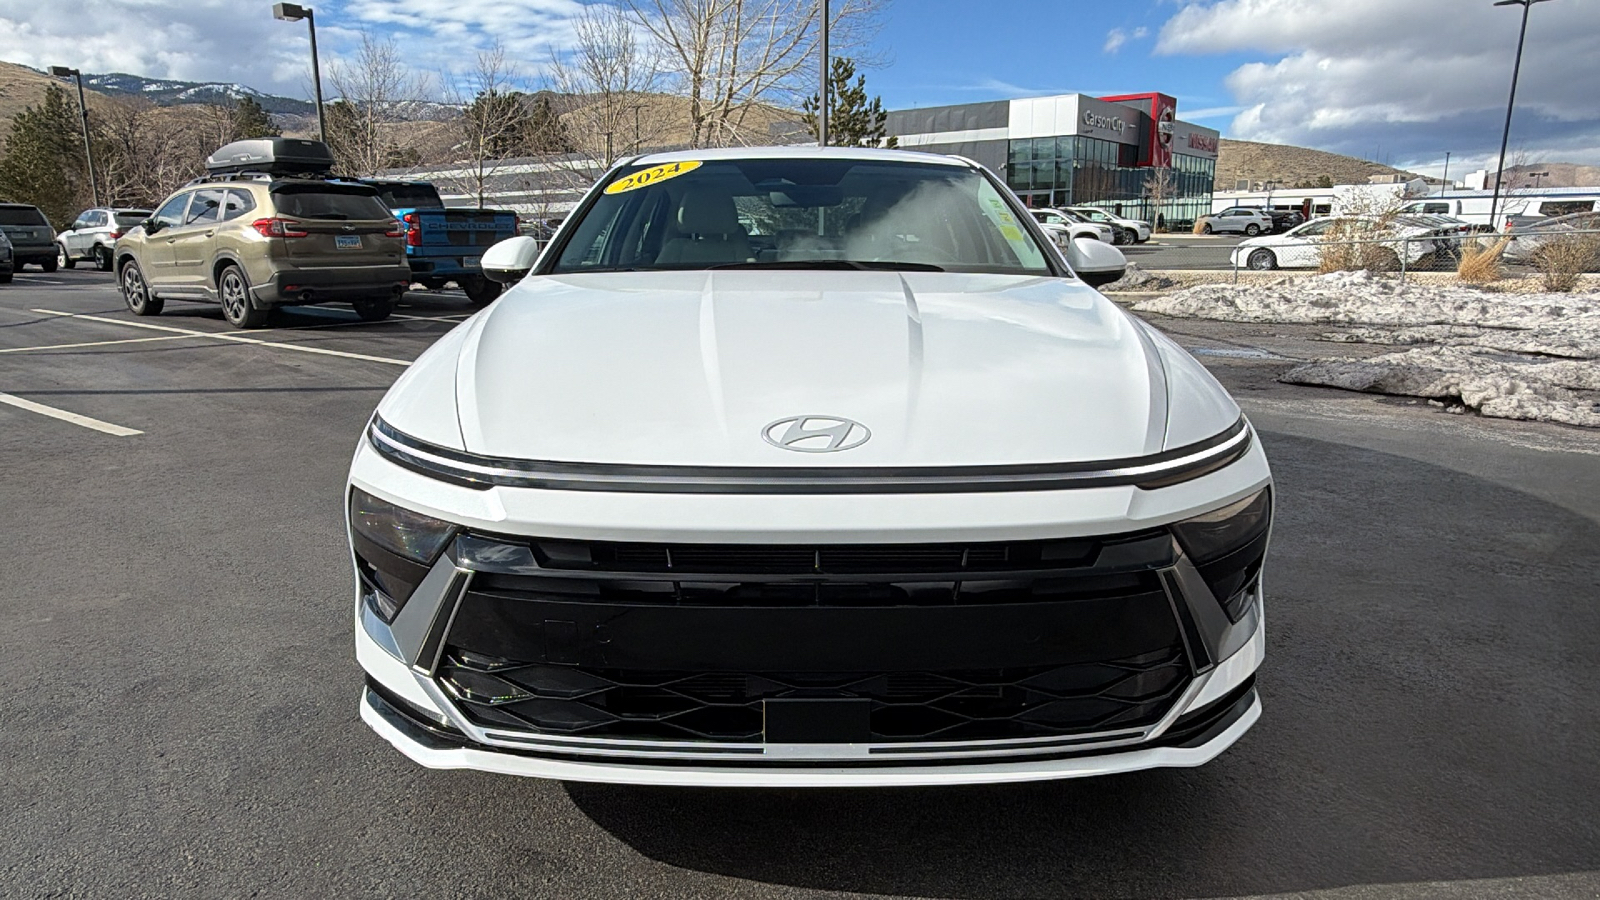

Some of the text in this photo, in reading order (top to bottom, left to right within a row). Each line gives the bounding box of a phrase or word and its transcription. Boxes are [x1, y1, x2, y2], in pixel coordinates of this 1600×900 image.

[1084, 110, 1126, 134] Carson City
[621, 163, 681, 191] 2024
[428, 222, 513, 230] CHEVROLET
